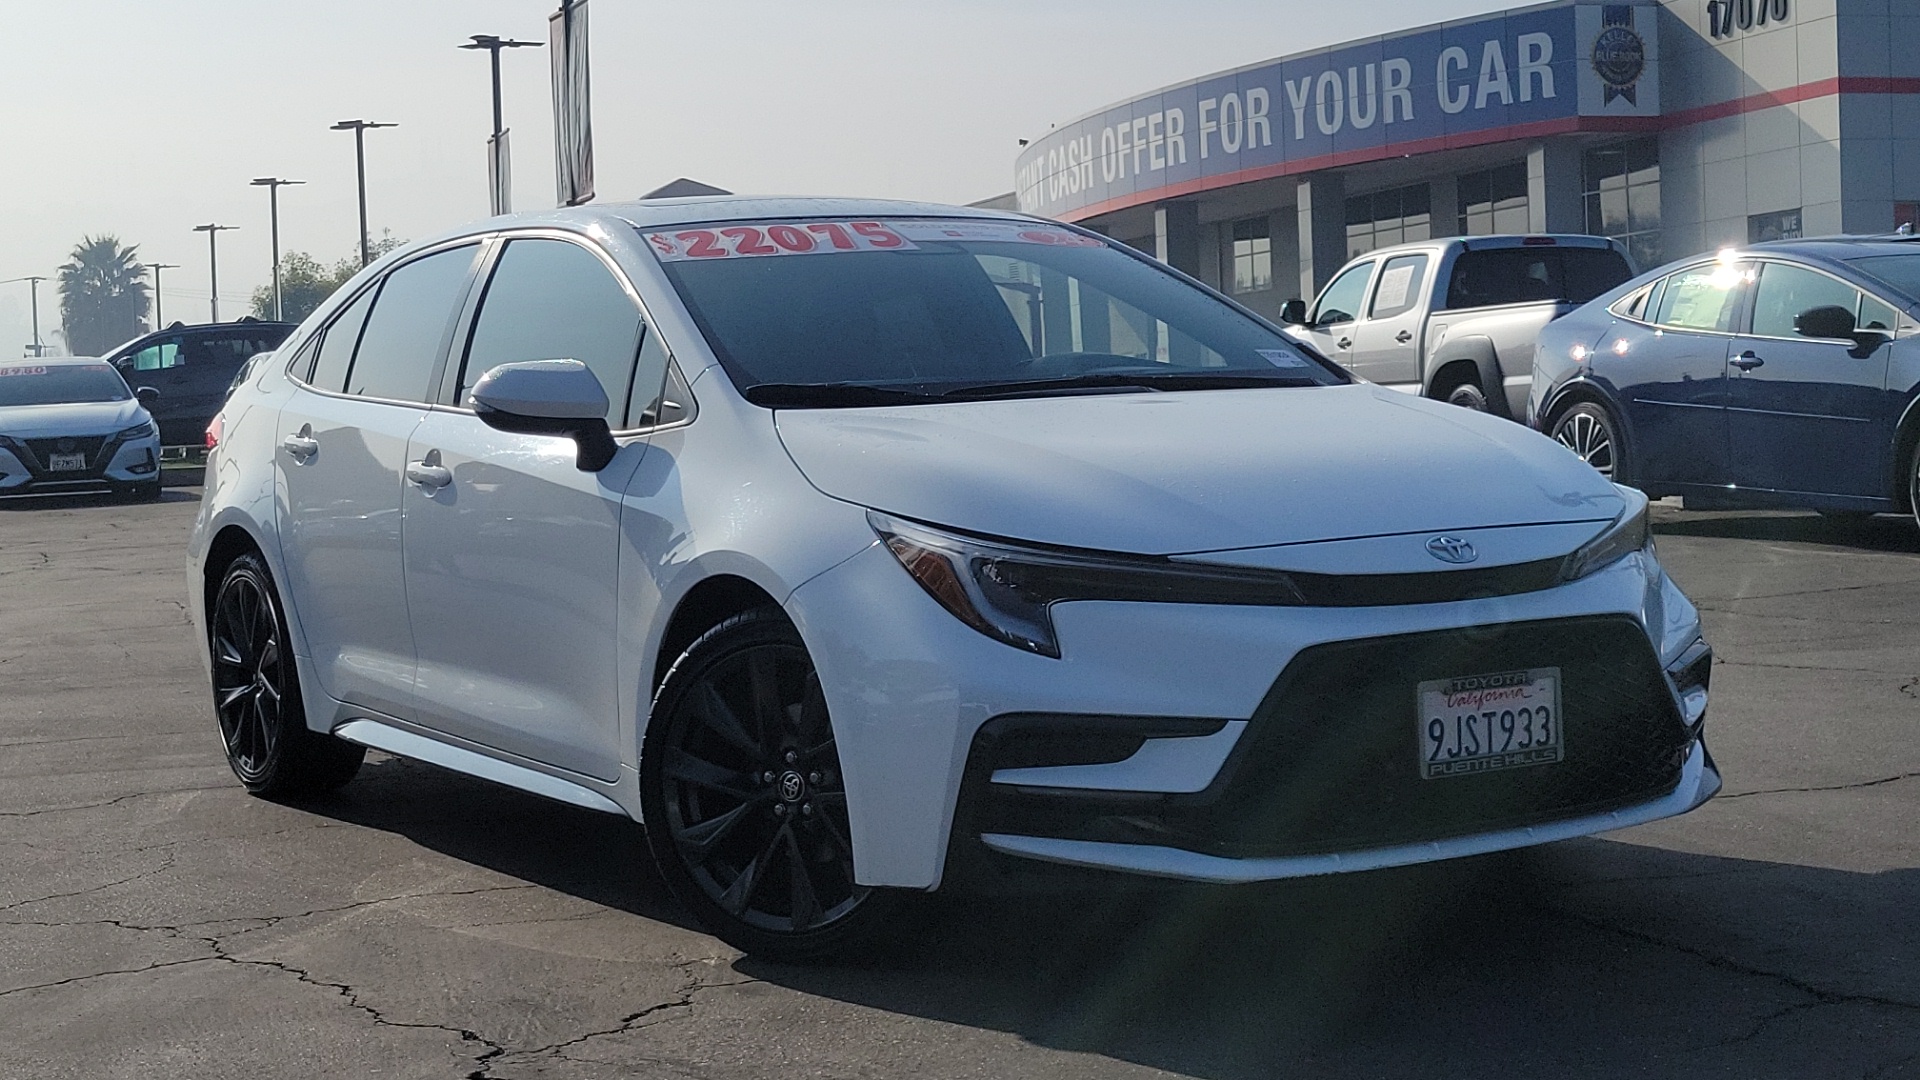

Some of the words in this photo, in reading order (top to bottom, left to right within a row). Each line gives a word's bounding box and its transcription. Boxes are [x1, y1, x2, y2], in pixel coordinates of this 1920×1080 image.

[1049, 134, 1094, 202] CASH
[1101, 107, 1187, 184] OFFER
[1198, 87, 1272, 159] FOR
[1285, 57, 1415, 141] YOUR
[1436, 32, 1557, 115] CAR
[1782, 215, 1798, 230] WE
[1453, 673, 1527, 690] TOYOTA
[1446, 686, 1533, 711] California
[1428, 705, 1551, 761] 9JST933
[1430, 755, 1502, 776] PUENTE
[1504, 750, 1557, 765] HILLS
